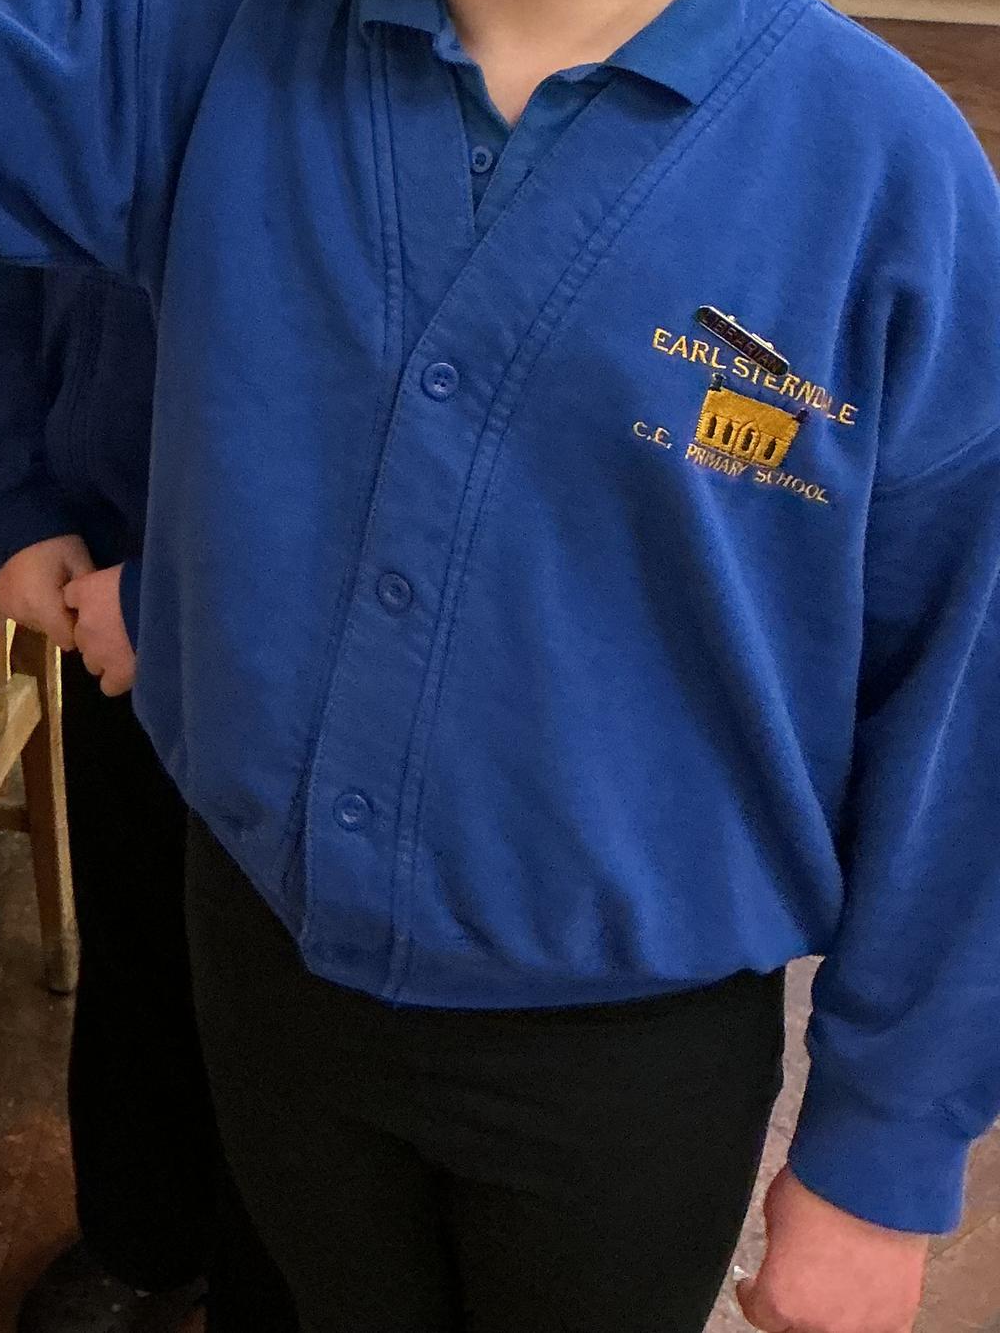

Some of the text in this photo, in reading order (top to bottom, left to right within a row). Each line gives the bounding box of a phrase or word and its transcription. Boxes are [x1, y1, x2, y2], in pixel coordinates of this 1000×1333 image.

[652, 328, 727, 370] EARL
[633, 421, 829, 504] C.E. PRIMARY SCHOOL
